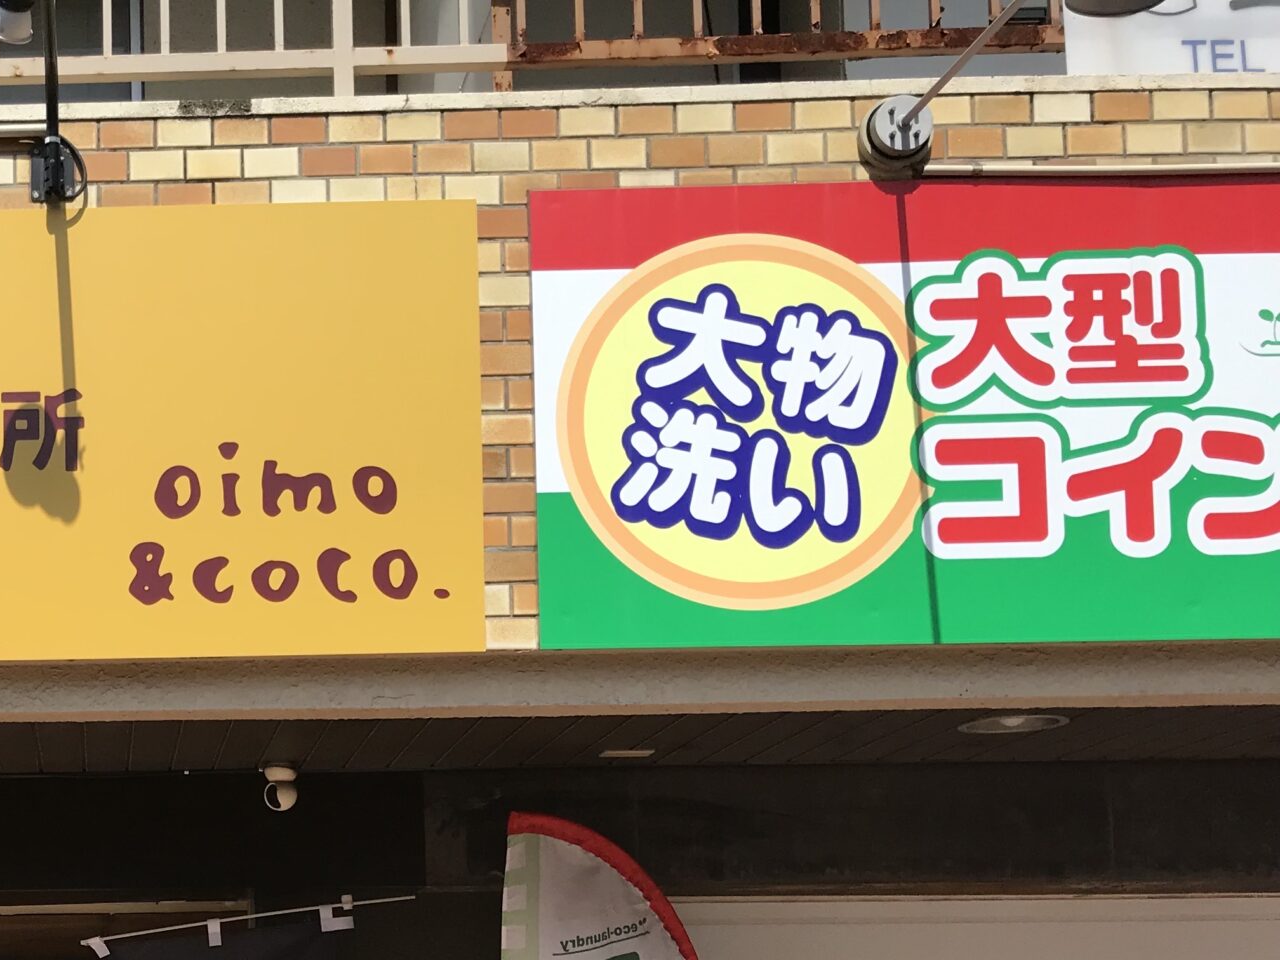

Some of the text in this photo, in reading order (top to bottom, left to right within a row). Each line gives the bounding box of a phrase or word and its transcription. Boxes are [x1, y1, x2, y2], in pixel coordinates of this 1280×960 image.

[1181, 39, 1266, 73] TEL
[642, 286, 892, 437] 大物
[927, 265, 1191, 392] 大型
[154, 441, 398, 519] oimo
[614, 398, 860, 545] 洗い
[128, 541, 450, 606] &coco.
